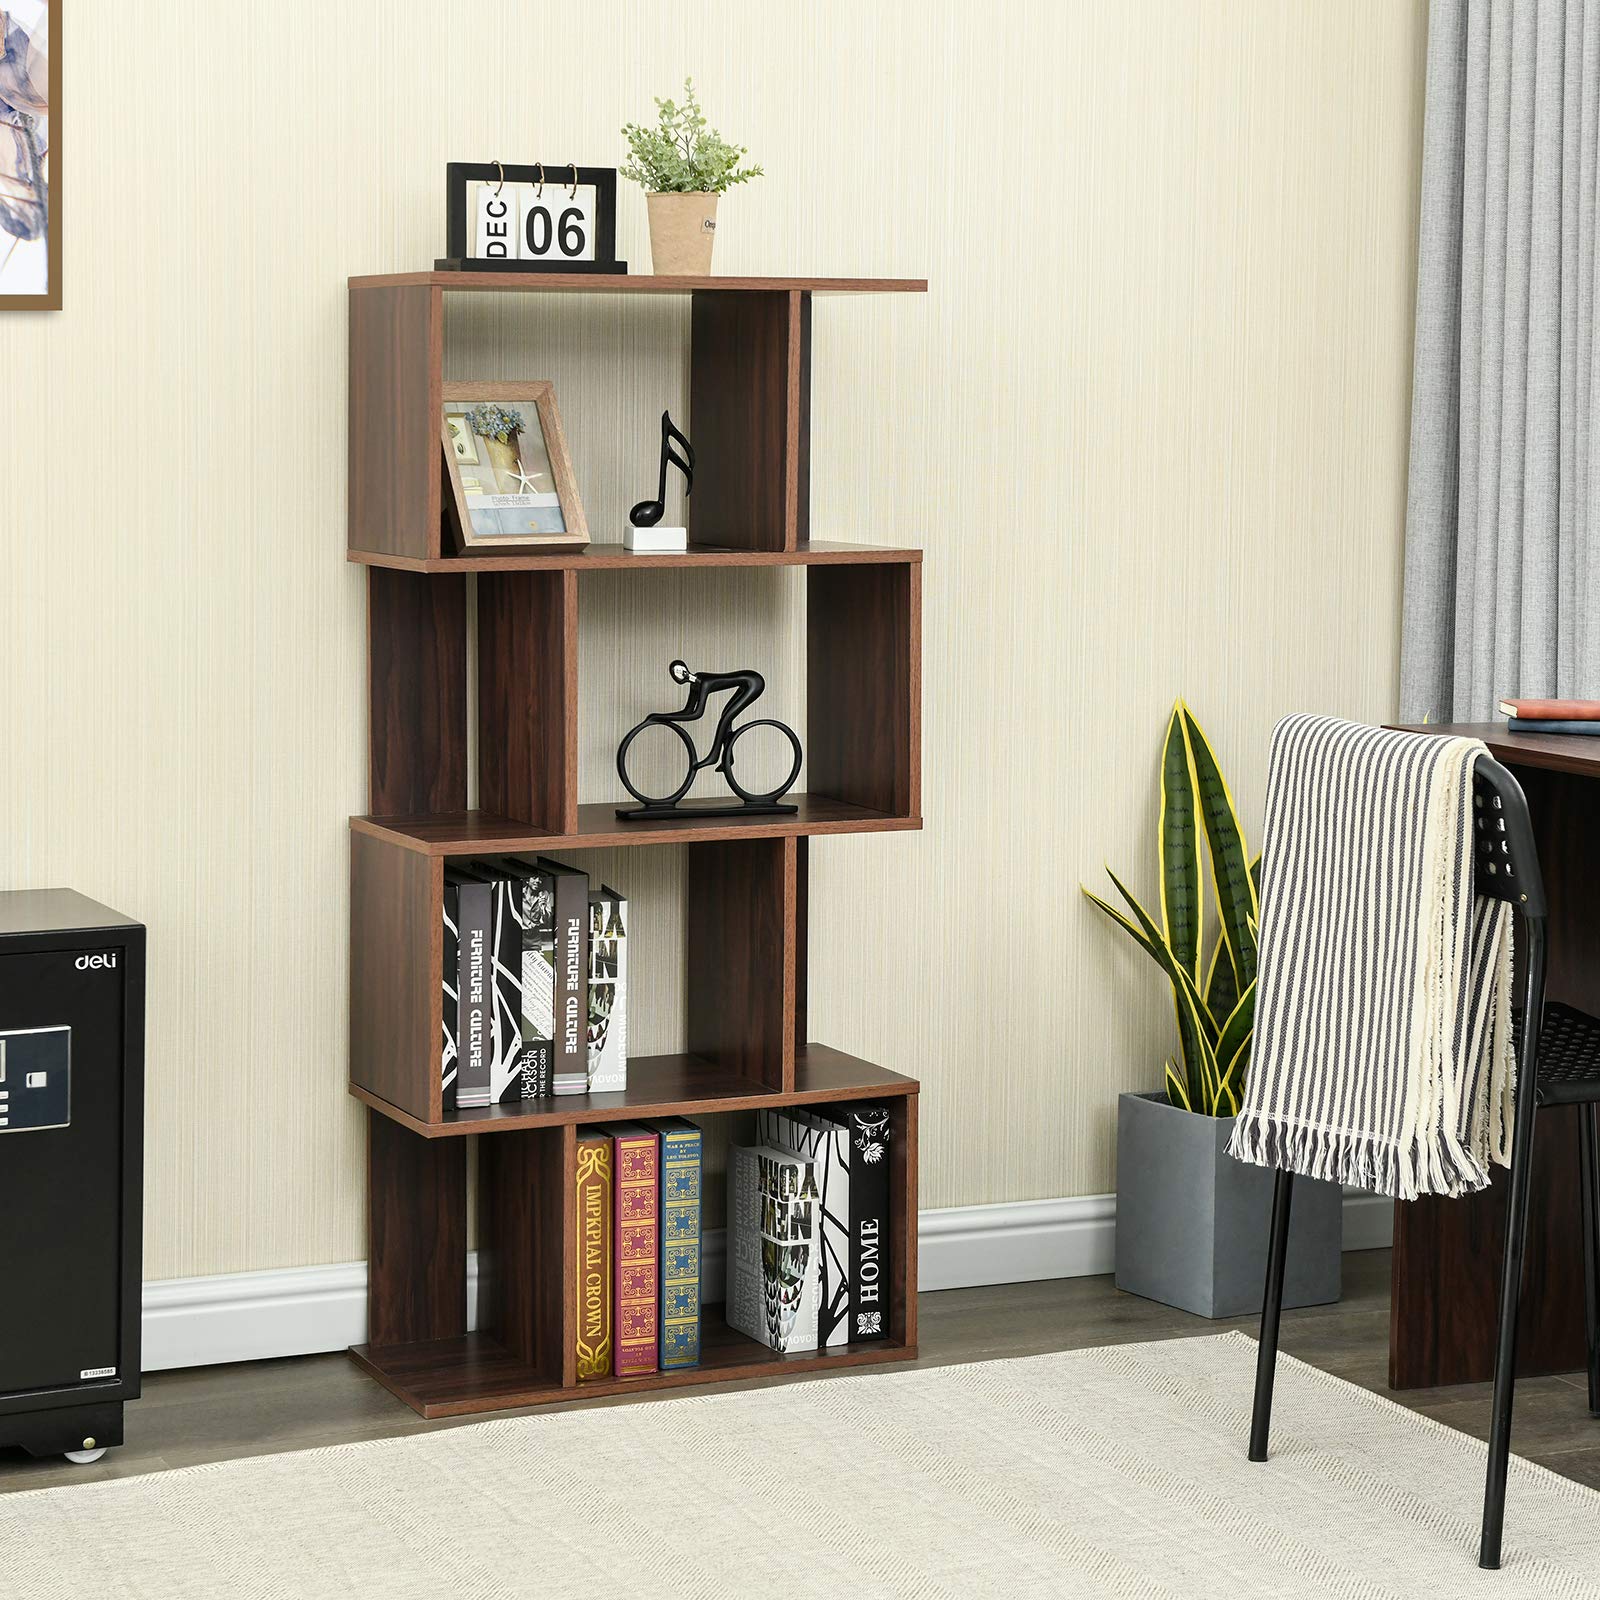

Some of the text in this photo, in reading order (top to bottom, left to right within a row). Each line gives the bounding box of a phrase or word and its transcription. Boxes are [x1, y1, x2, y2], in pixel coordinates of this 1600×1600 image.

[486, 200, 586, 258] DEC 06
[75, 953, 117, 970] deli
[469, 1009, 482, 1067] CULTURE
[565, 996, 579, 1054] CULTURE
[528, 1050, 538, 1098] ACKSON
[860, 1218, 879, 1304] HOME
[586, 1273, 602, 1338] CROWN
